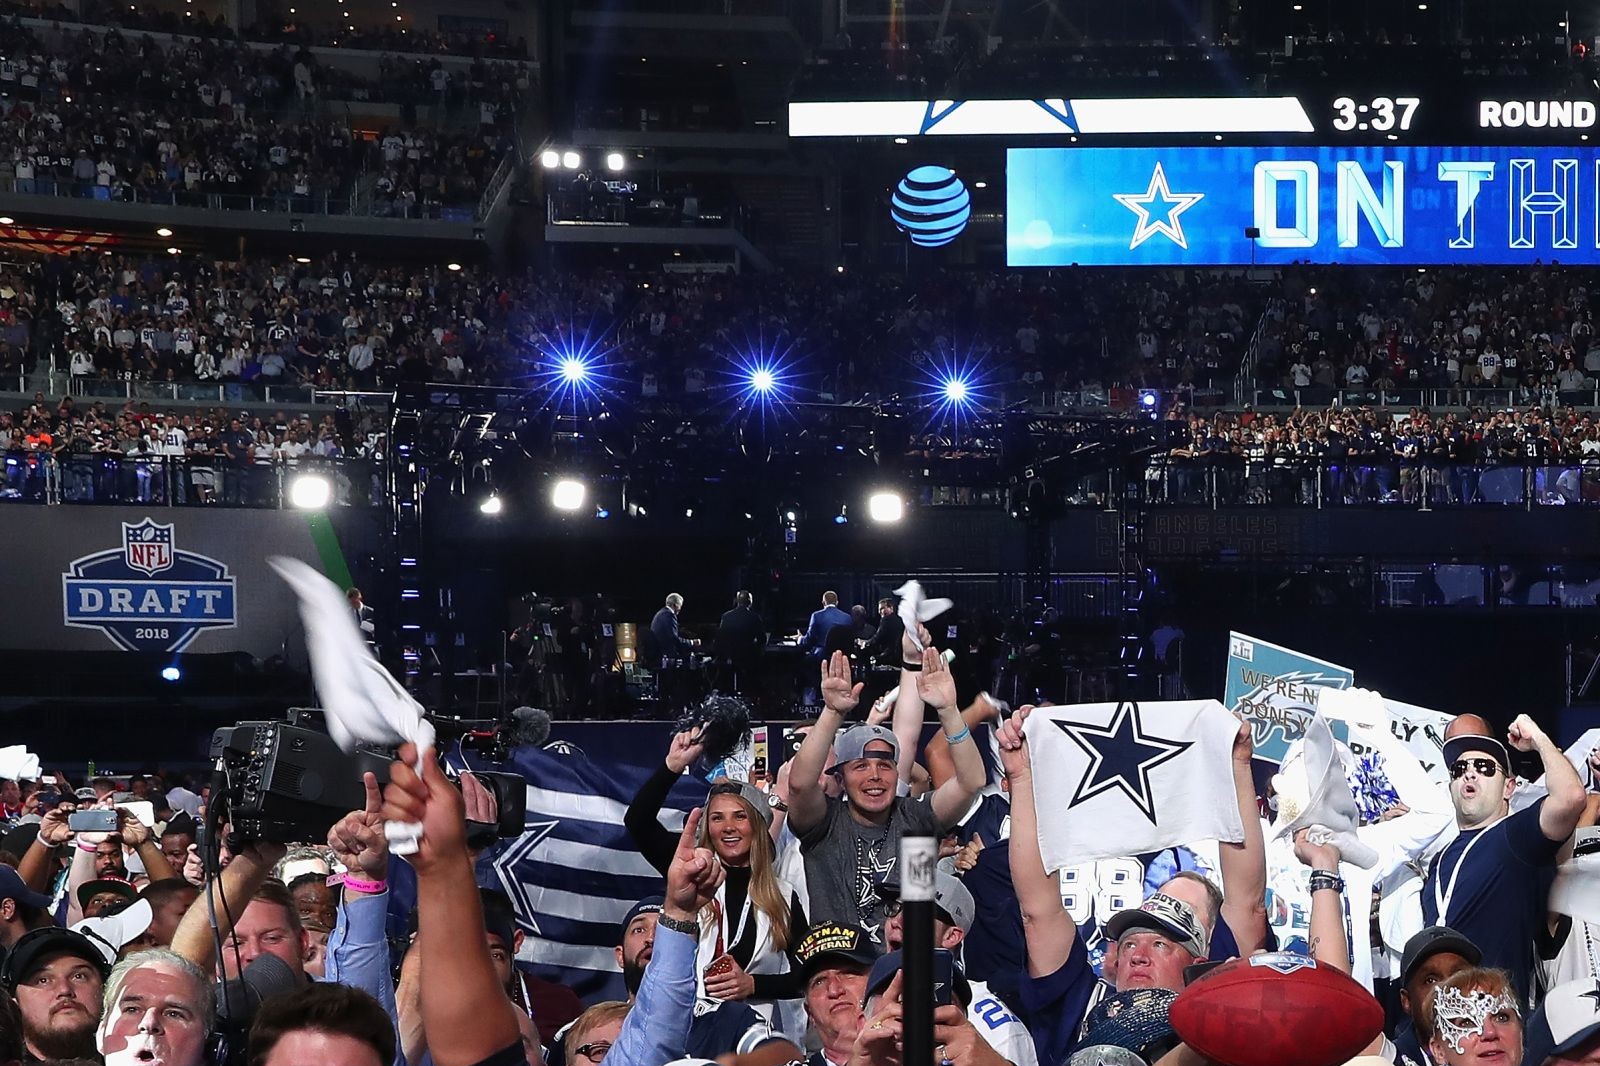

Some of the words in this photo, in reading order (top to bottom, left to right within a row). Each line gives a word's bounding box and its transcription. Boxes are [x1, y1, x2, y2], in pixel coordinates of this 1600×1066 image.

[1332, 97, 1420, 131] 3:37
[1479, 100, 1596, 130] ROUND
[1254, 160, 1405, 249] ON
[1483, 356, 1495, 367] 88
[167, 434, 180, 447] 21
[1527, 443, 1537, 458] 21
[131, 543, 169, 567] NFL
[78, 587, 222, 615] DRAFT
[135, 627, 170, 640] 2018
[1241, 667, 1297, 700] WE'RE
[1241, 698, 1293, 728] DONE
[796, 927, 857, 955] VIETNAM
[802, 938, 852, 961] VETERAN
